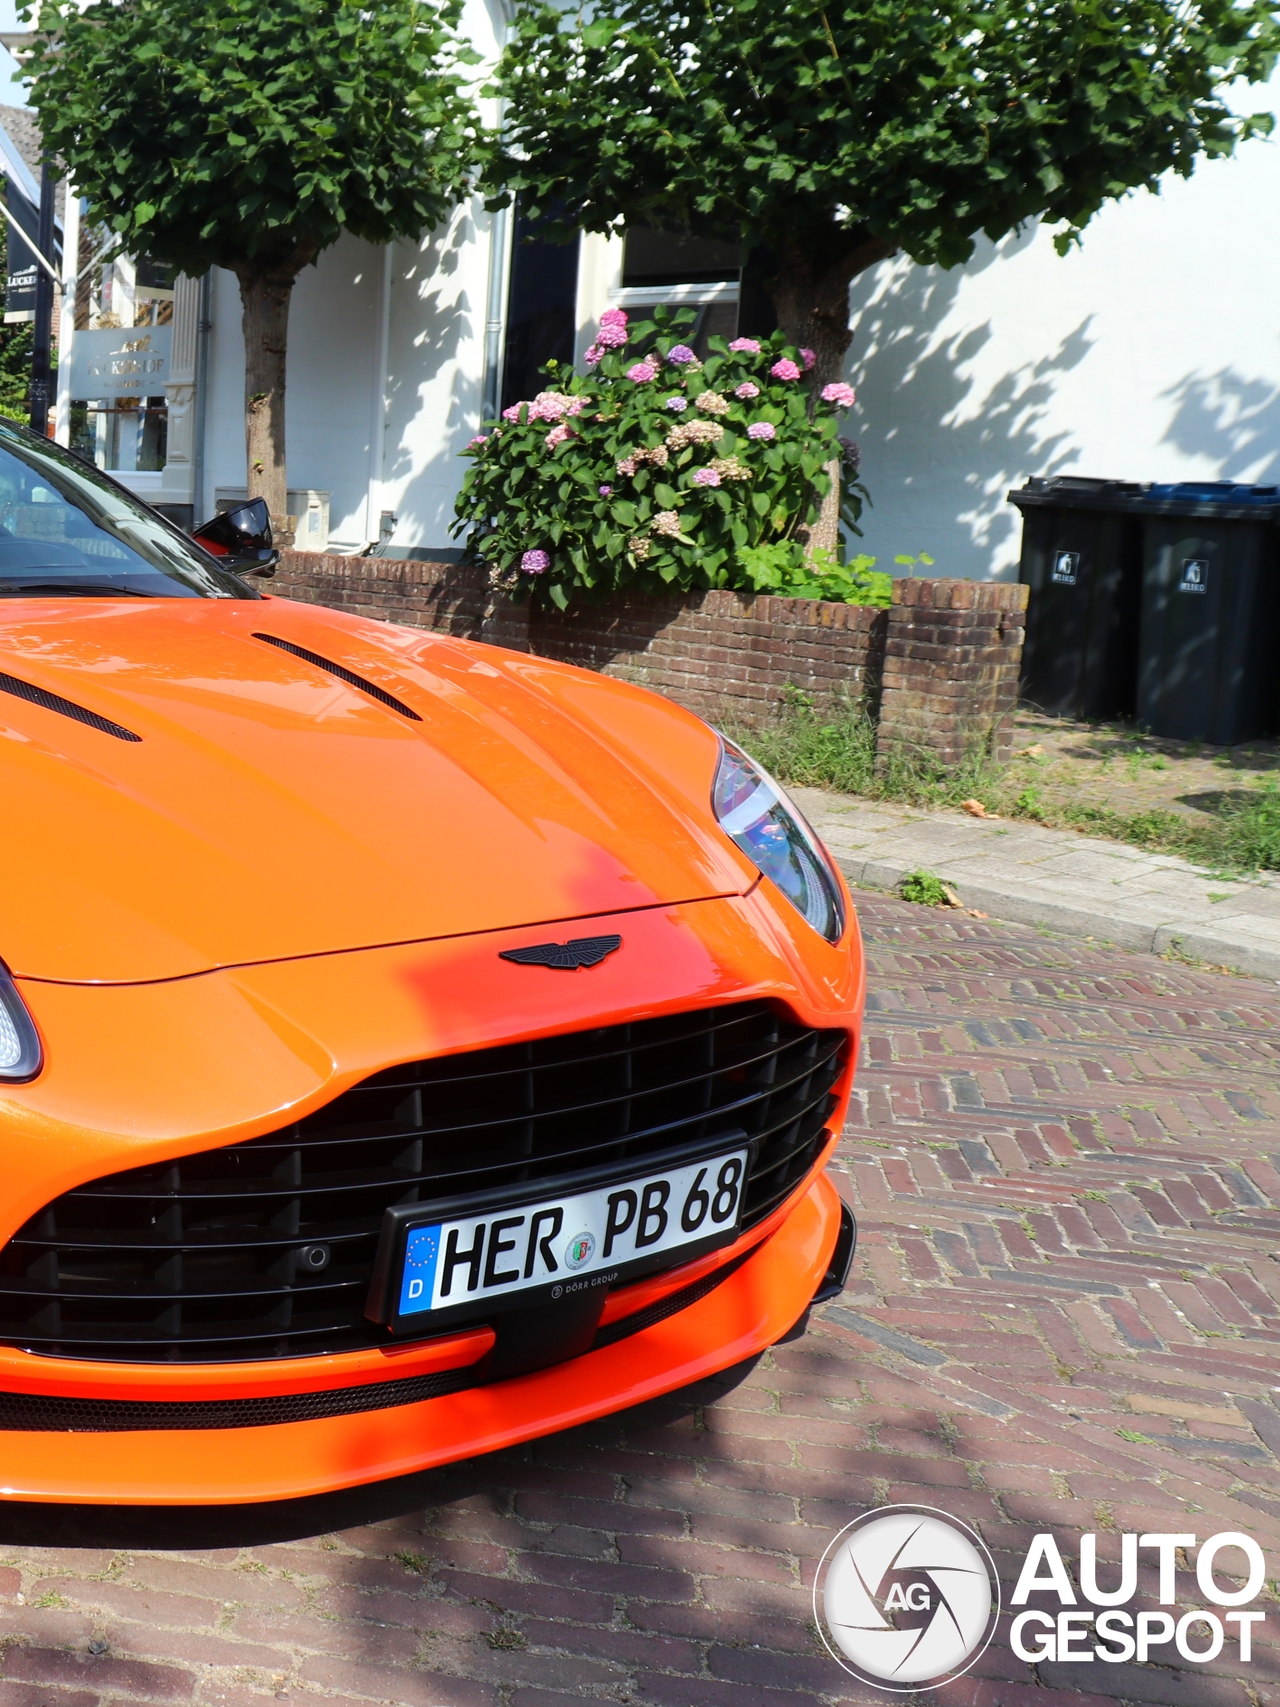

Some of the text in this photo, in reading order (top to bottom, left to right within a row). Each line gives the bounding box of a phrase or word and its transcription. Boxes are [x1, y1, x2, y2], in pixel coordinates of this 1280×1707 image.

[1053, 573, 1075, 583] KLIKO
[1180, 582, 1205, 592] KLIKO
[543, 942, 595, 957] ASTON MARTIN
[440, 1206, 564, 1298] HER
[603, 1180, 671, 1258] PB
[681, 1158, 743, 1233] 68
[408, 1279, 424, 1299] D
[565, 1281, 589, 1293] DÖRR
[590, 1272, 619, 1287] GROUP
